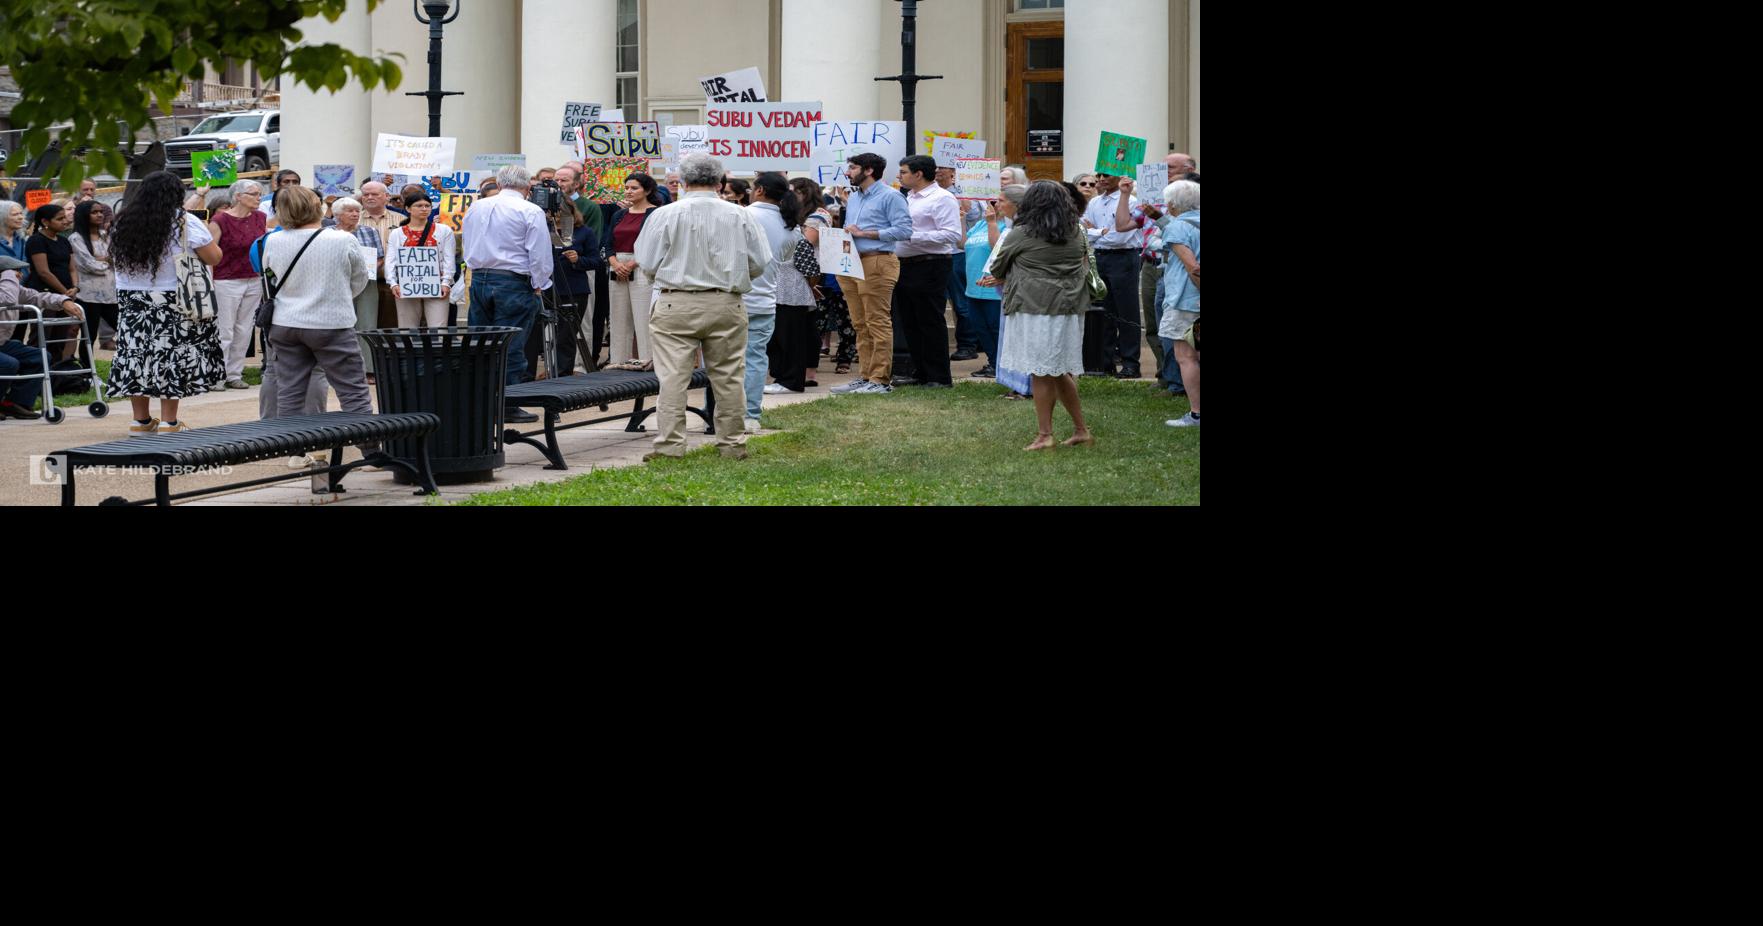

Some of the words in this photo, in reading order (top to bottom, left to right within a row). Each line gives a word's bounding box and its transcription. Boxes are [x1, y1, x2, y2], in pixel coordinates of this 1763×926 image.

[564, 104, 602, 117] FREE
[707, 110, 753, 128] SUBU
[757, 111, 822, 128] VEDAM
[814, 122, 892, 146] FAIR
[709, 139, 732, 156] IS
[737, 140, 811, 158] INNOCEN
[943, 141, 965, 150] FAIR
[818, 165, 848, 184] FA
[448, 194, 483, 213] FR
[398, 247, 437, 264] FAIR
[398, 264, 439, 278] TRIAL
[402, 282, 440, 296] SUBU
